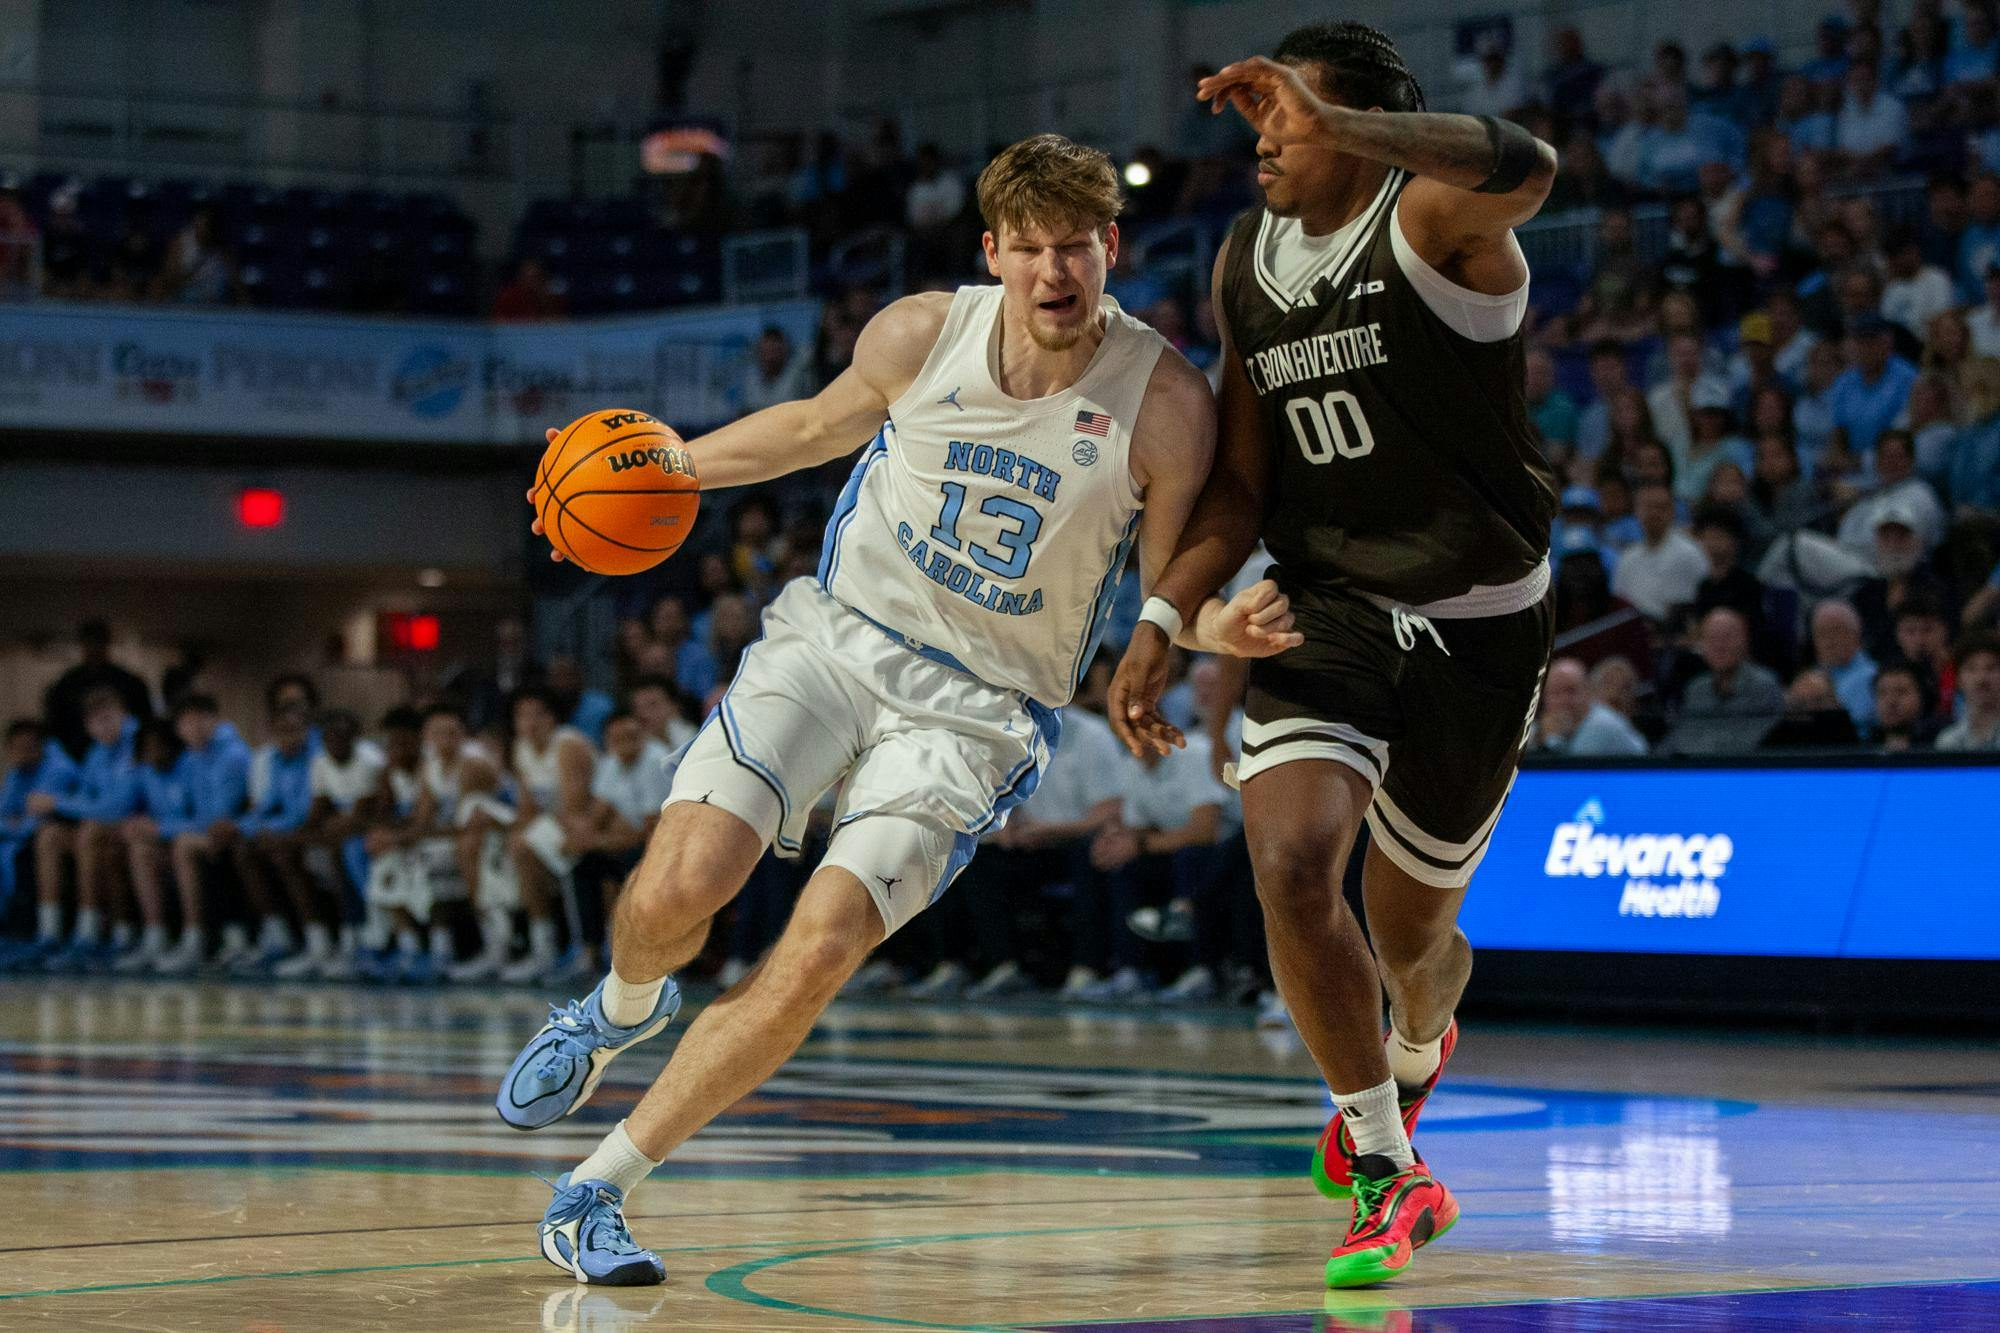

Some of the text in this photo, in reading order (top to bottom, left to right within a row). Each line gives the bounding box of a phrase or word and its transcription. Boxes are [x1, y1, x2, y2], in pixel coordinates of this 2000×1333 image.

[601, 413, 657, 430] CAA
[1285, 390, 1375, 466] 00
[607, 447, 697, 481] Wilson
[944, 441, 1062, 503] NORTH
[930, 481, 1044, 579] 13
[897, 521, 1044, 616] CAROLINA
[1545, 821, 1734, 879] Elevance
[1618, 877, 1721, 919] Health
